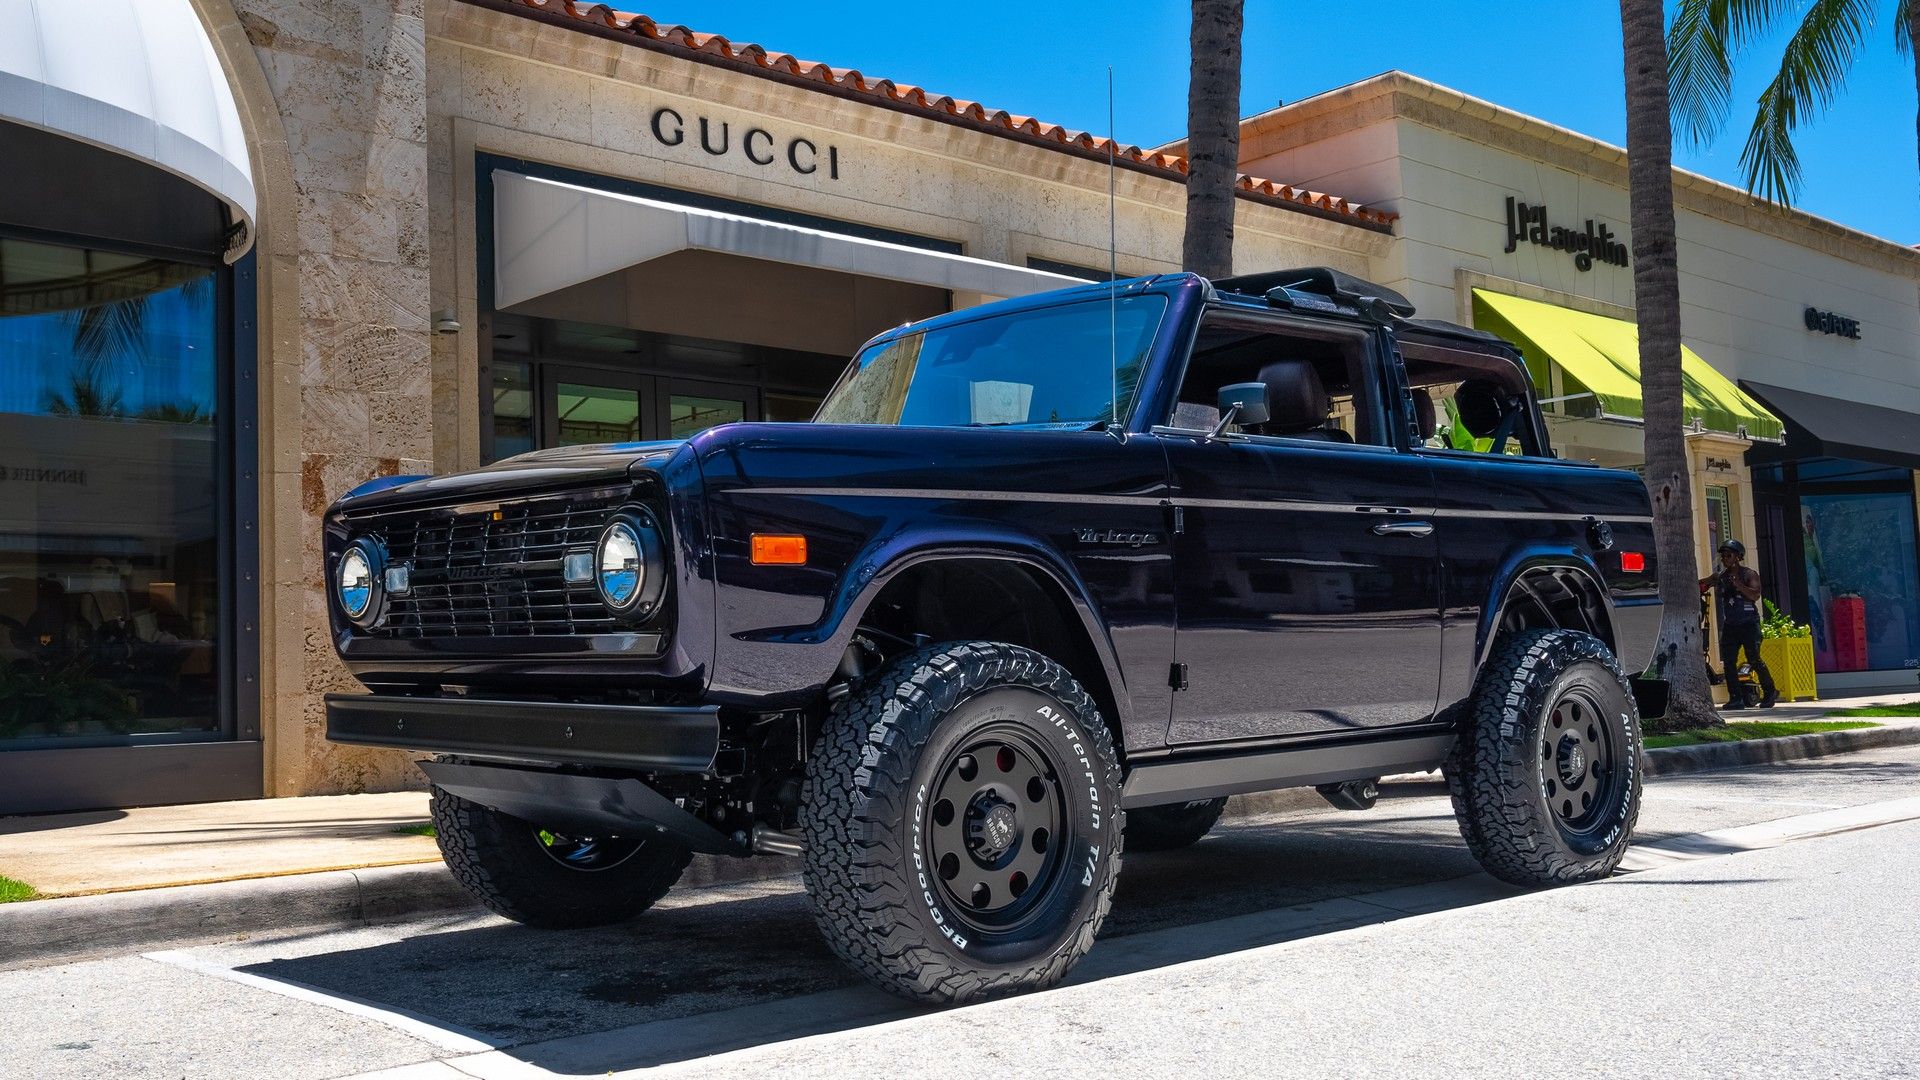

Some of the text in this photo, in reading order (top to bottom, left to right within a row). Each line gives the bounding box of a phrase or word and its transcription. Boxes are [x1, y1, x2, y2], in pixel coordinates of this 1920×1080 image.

[651, 107, 838, 180] GUCCI
[1036, 705, 1101, 887] All-Terrain T/A
[1620, 712, 1635, 820] All-Terrain
[912, 784, 968, 950] BFGoodrich
[986, 818, 1003, 848] BRONCOS
